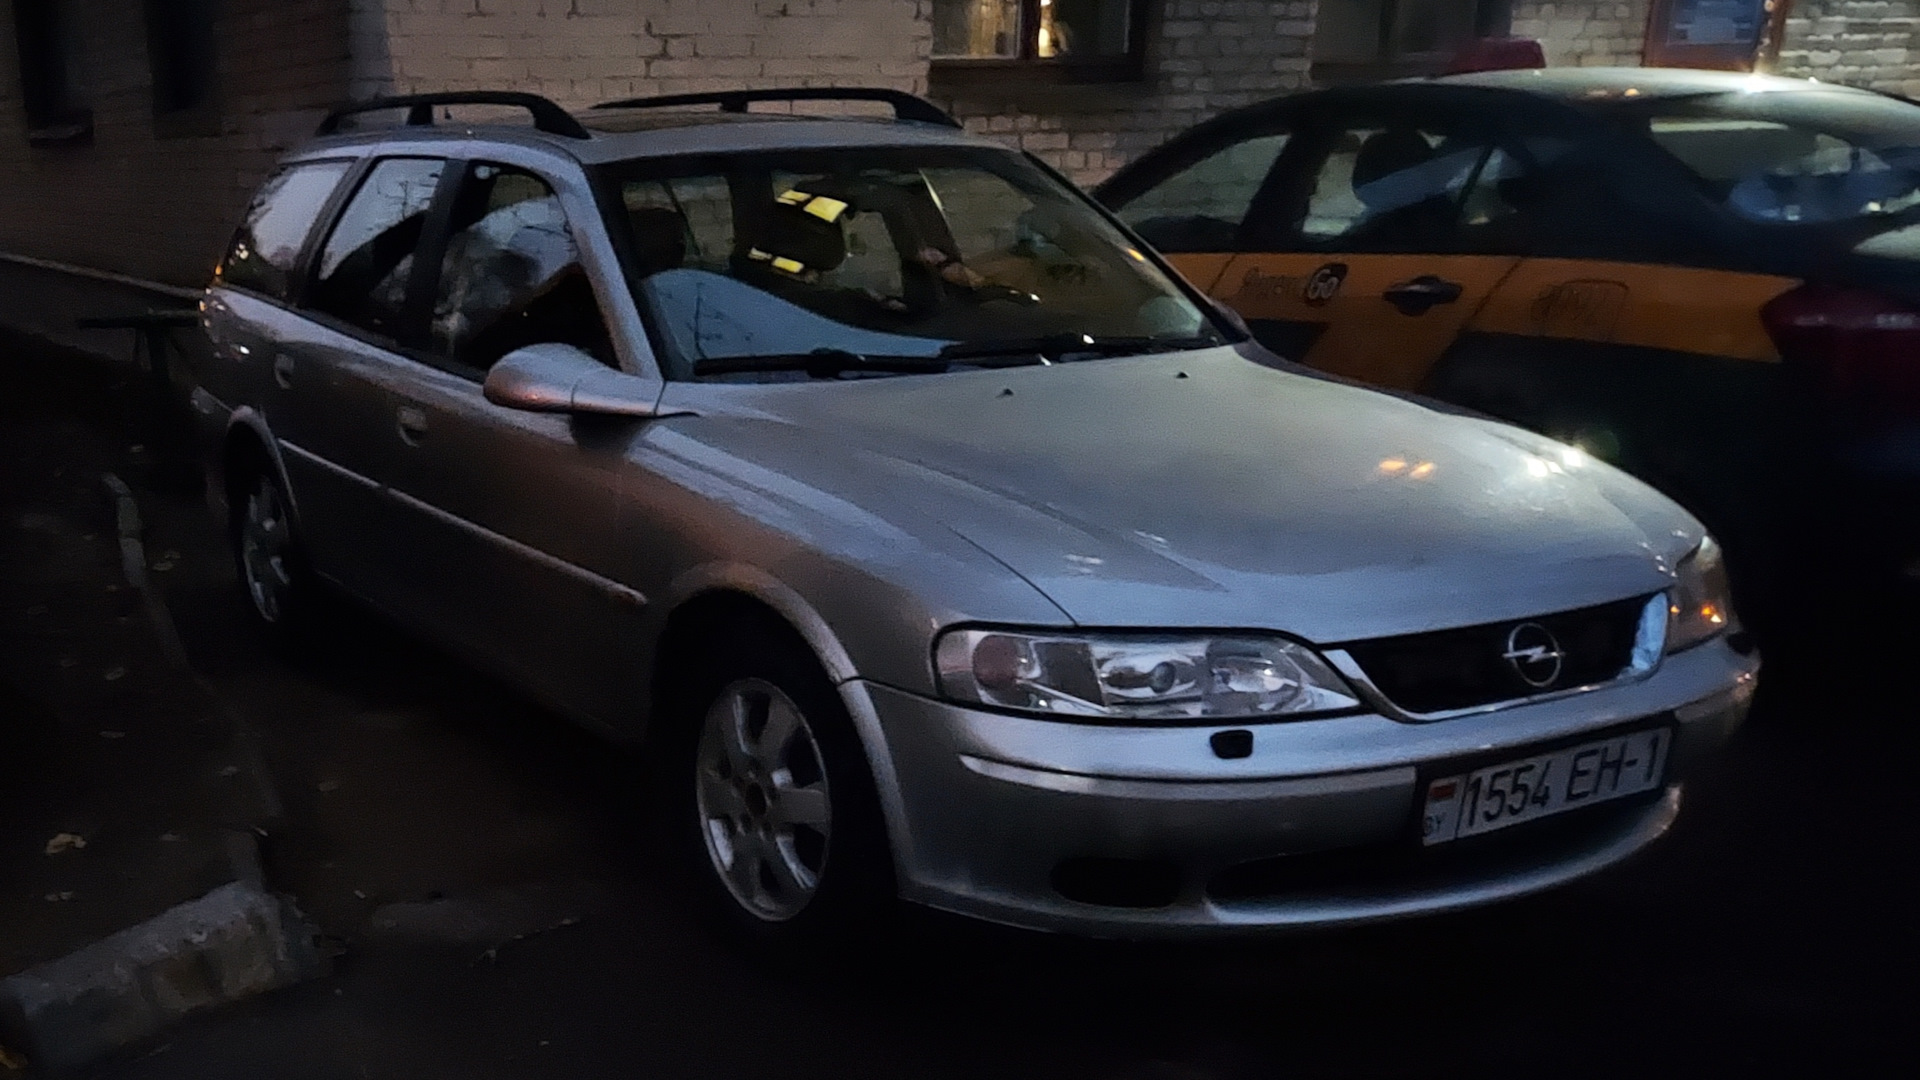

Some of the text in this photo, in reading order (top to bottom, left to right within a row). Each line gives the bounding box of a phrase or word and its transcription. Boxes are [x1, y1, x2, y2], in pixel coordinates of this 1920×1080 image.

[1307, 268, 1340, 300] Go
[1467, 735, 1659, 827] 1554 EH-1
